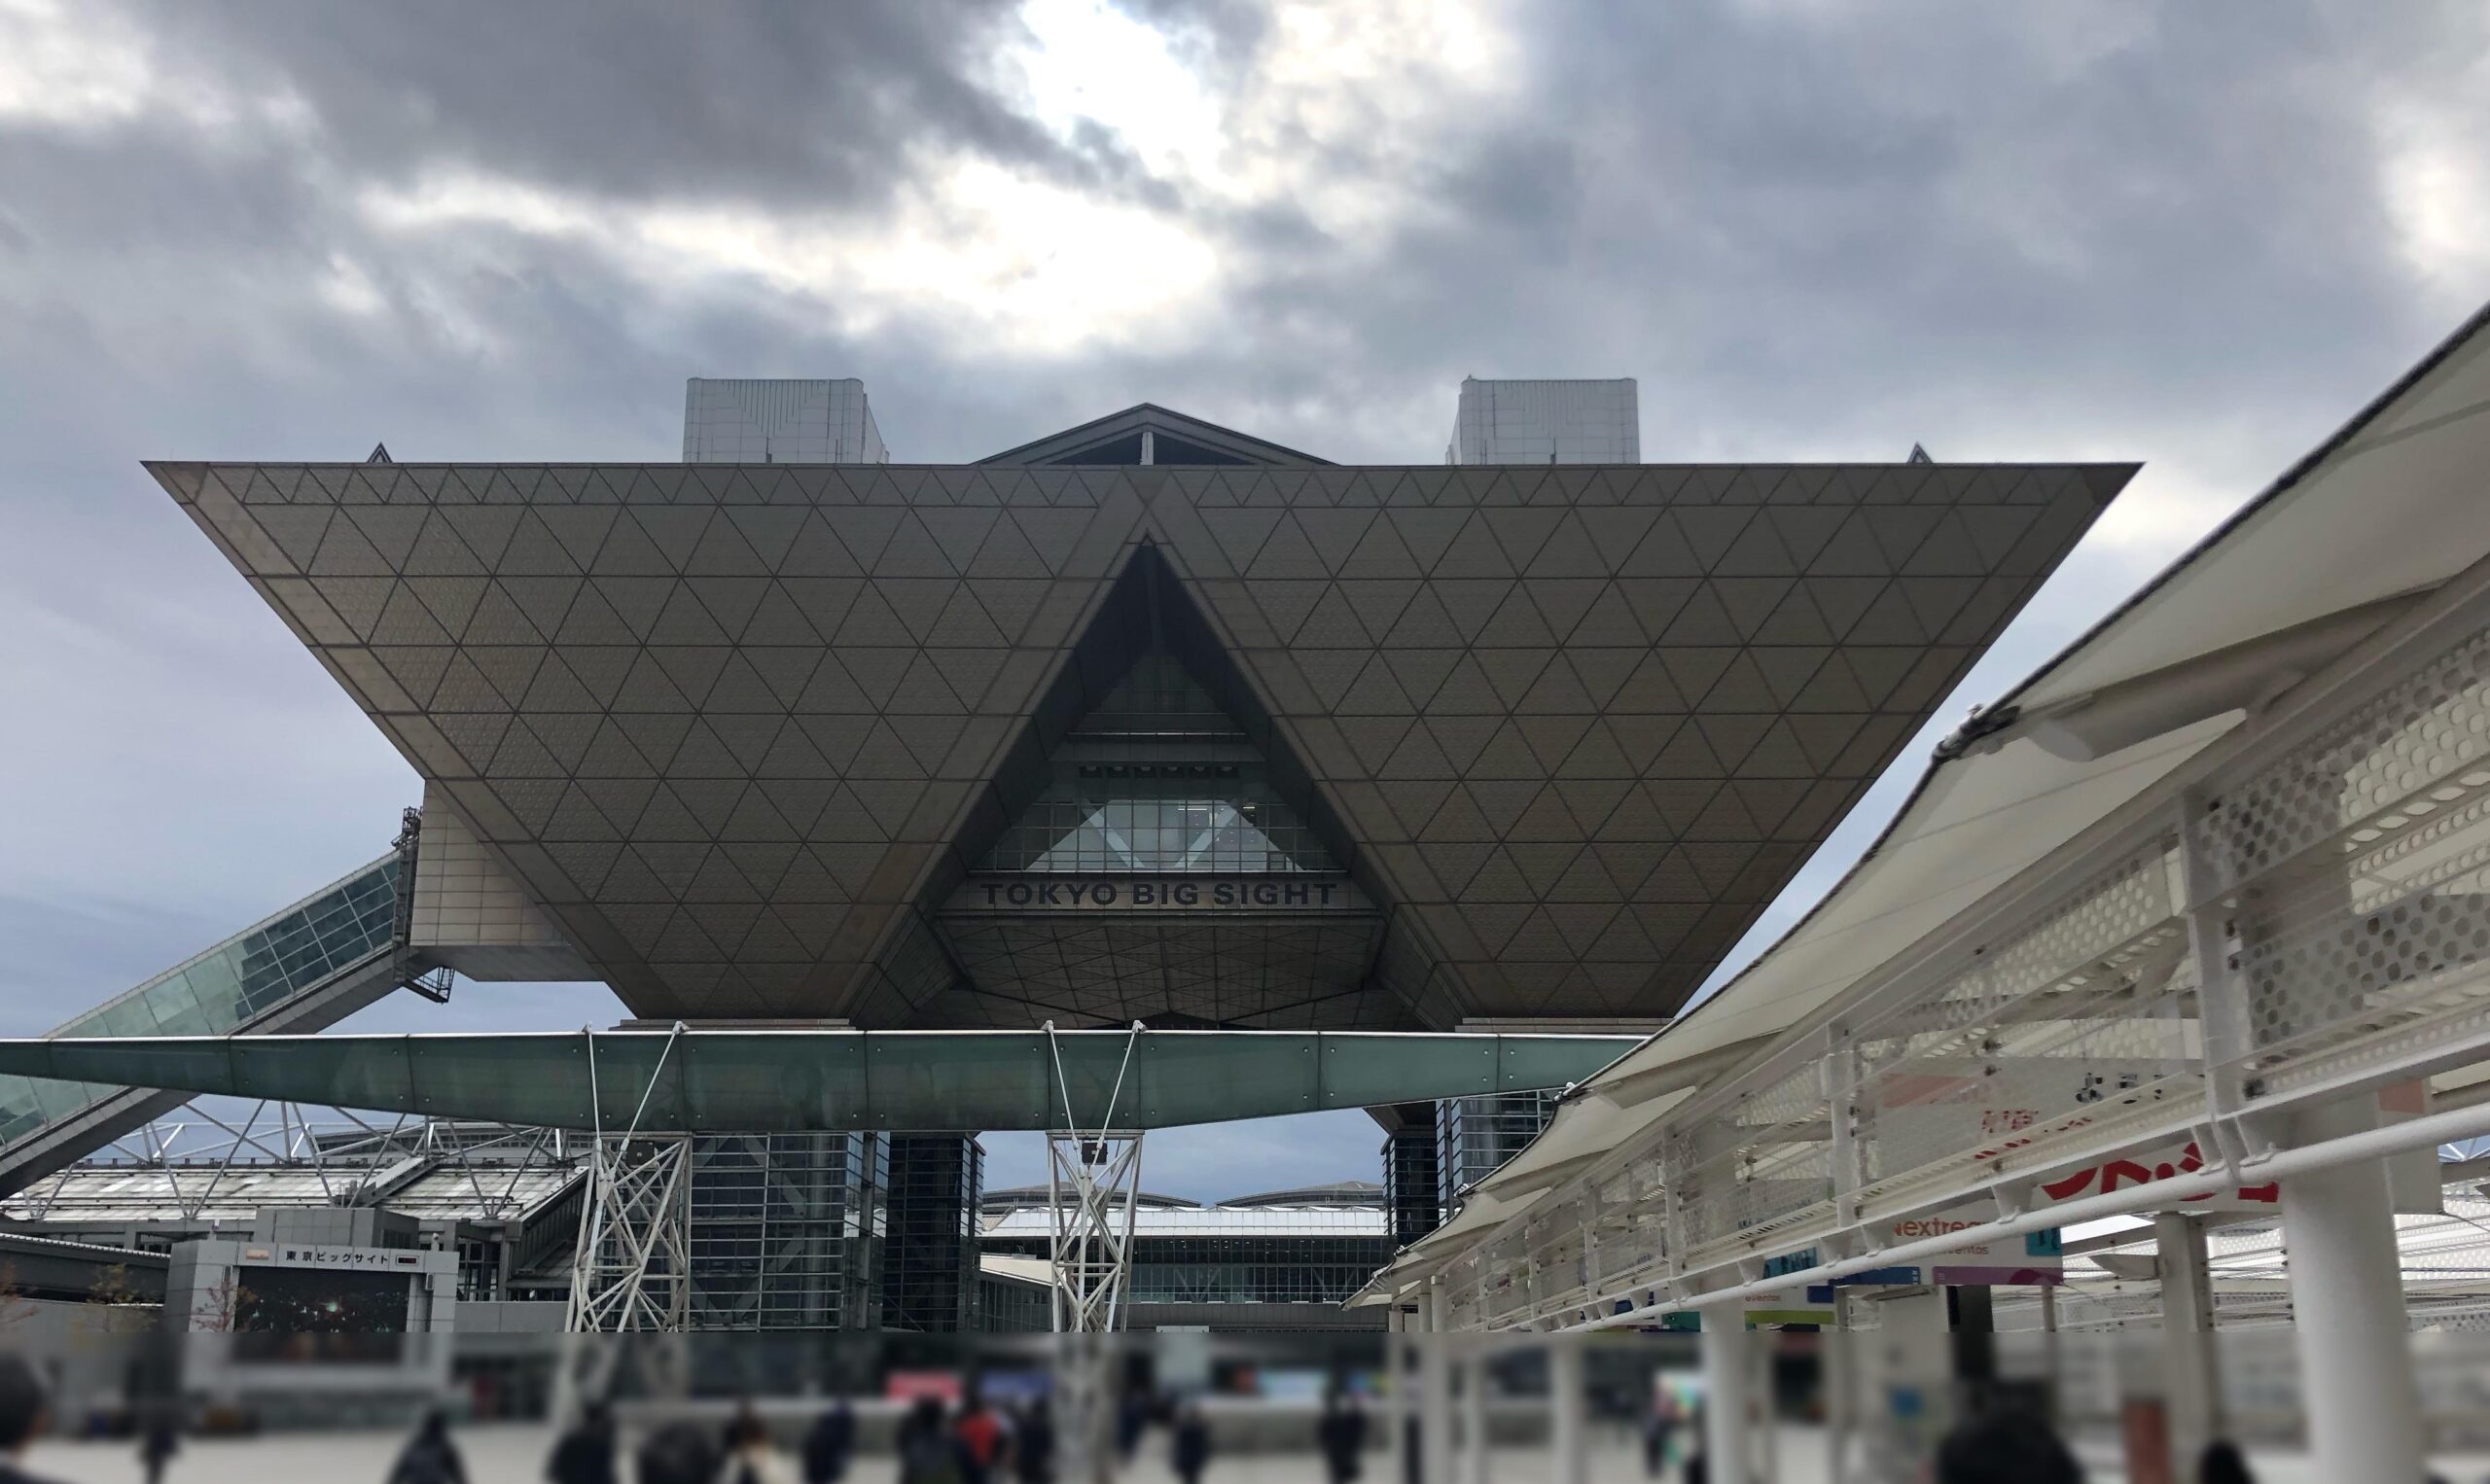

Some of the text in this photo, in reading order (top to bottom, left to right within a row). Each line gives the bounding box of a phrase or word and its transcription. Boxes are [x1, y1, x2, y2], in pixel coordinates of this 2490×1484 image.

[979, 883, 1336, 905] TOKYO BIG SIGHT
[286, 1250, 388, 1264] 東京ビッグサイト
